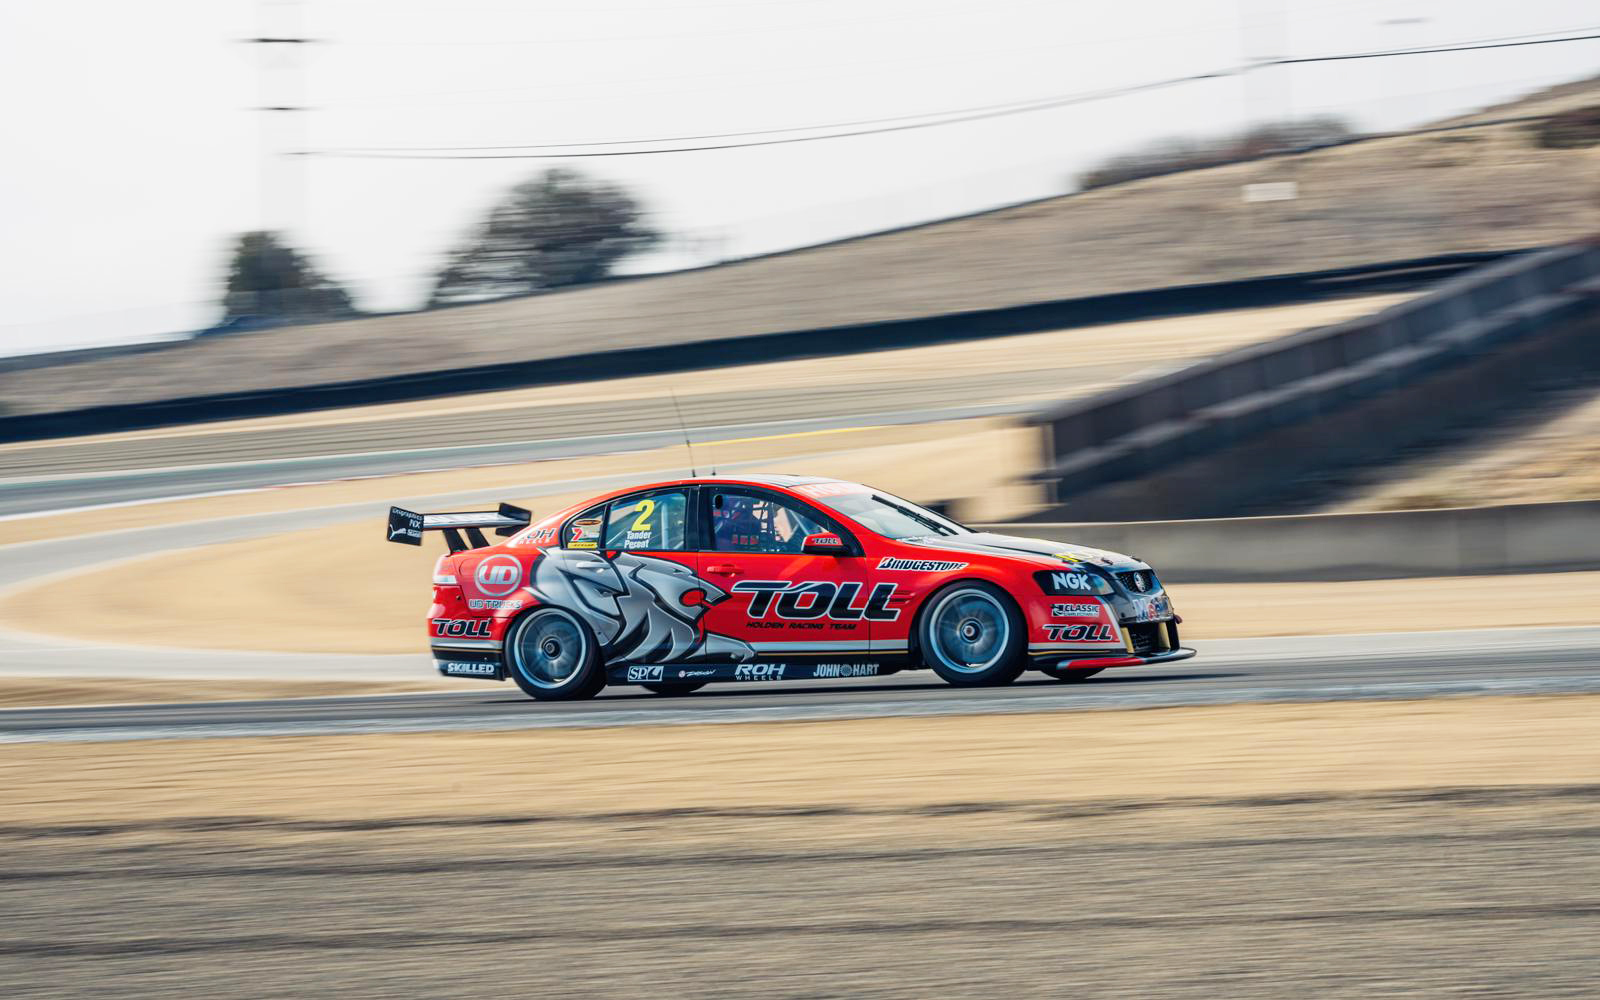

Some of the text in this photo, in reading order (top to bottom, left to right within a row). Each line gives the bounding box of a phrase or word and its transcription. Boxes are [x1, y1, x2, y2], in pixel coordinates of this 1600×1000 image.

[632, 499, 655, 531] 2
[409, 519, 421, 529] NX
[626, 530, 652, 540] Tander
[811, 537, 839, 545] TOLL
[478, 565, 518, 585] UD
[1051, 572, 1092, 591] NGK
[469, 599, 484, 609] UD
[731, 579, 901, 622] TOLL
[1065, 603, 1099, 613] CLASSIC
[432, 618, 492, 637] TOLL
[746, 621, 858, 630] HOLDEN RACING TEAM
[1043, 624, 1113, 641] TOLL
[447, 662, 495, 673] SKILLED
[735, 663, 786, 676] ROH
[813, 663, 880, 678] JOHN HART
